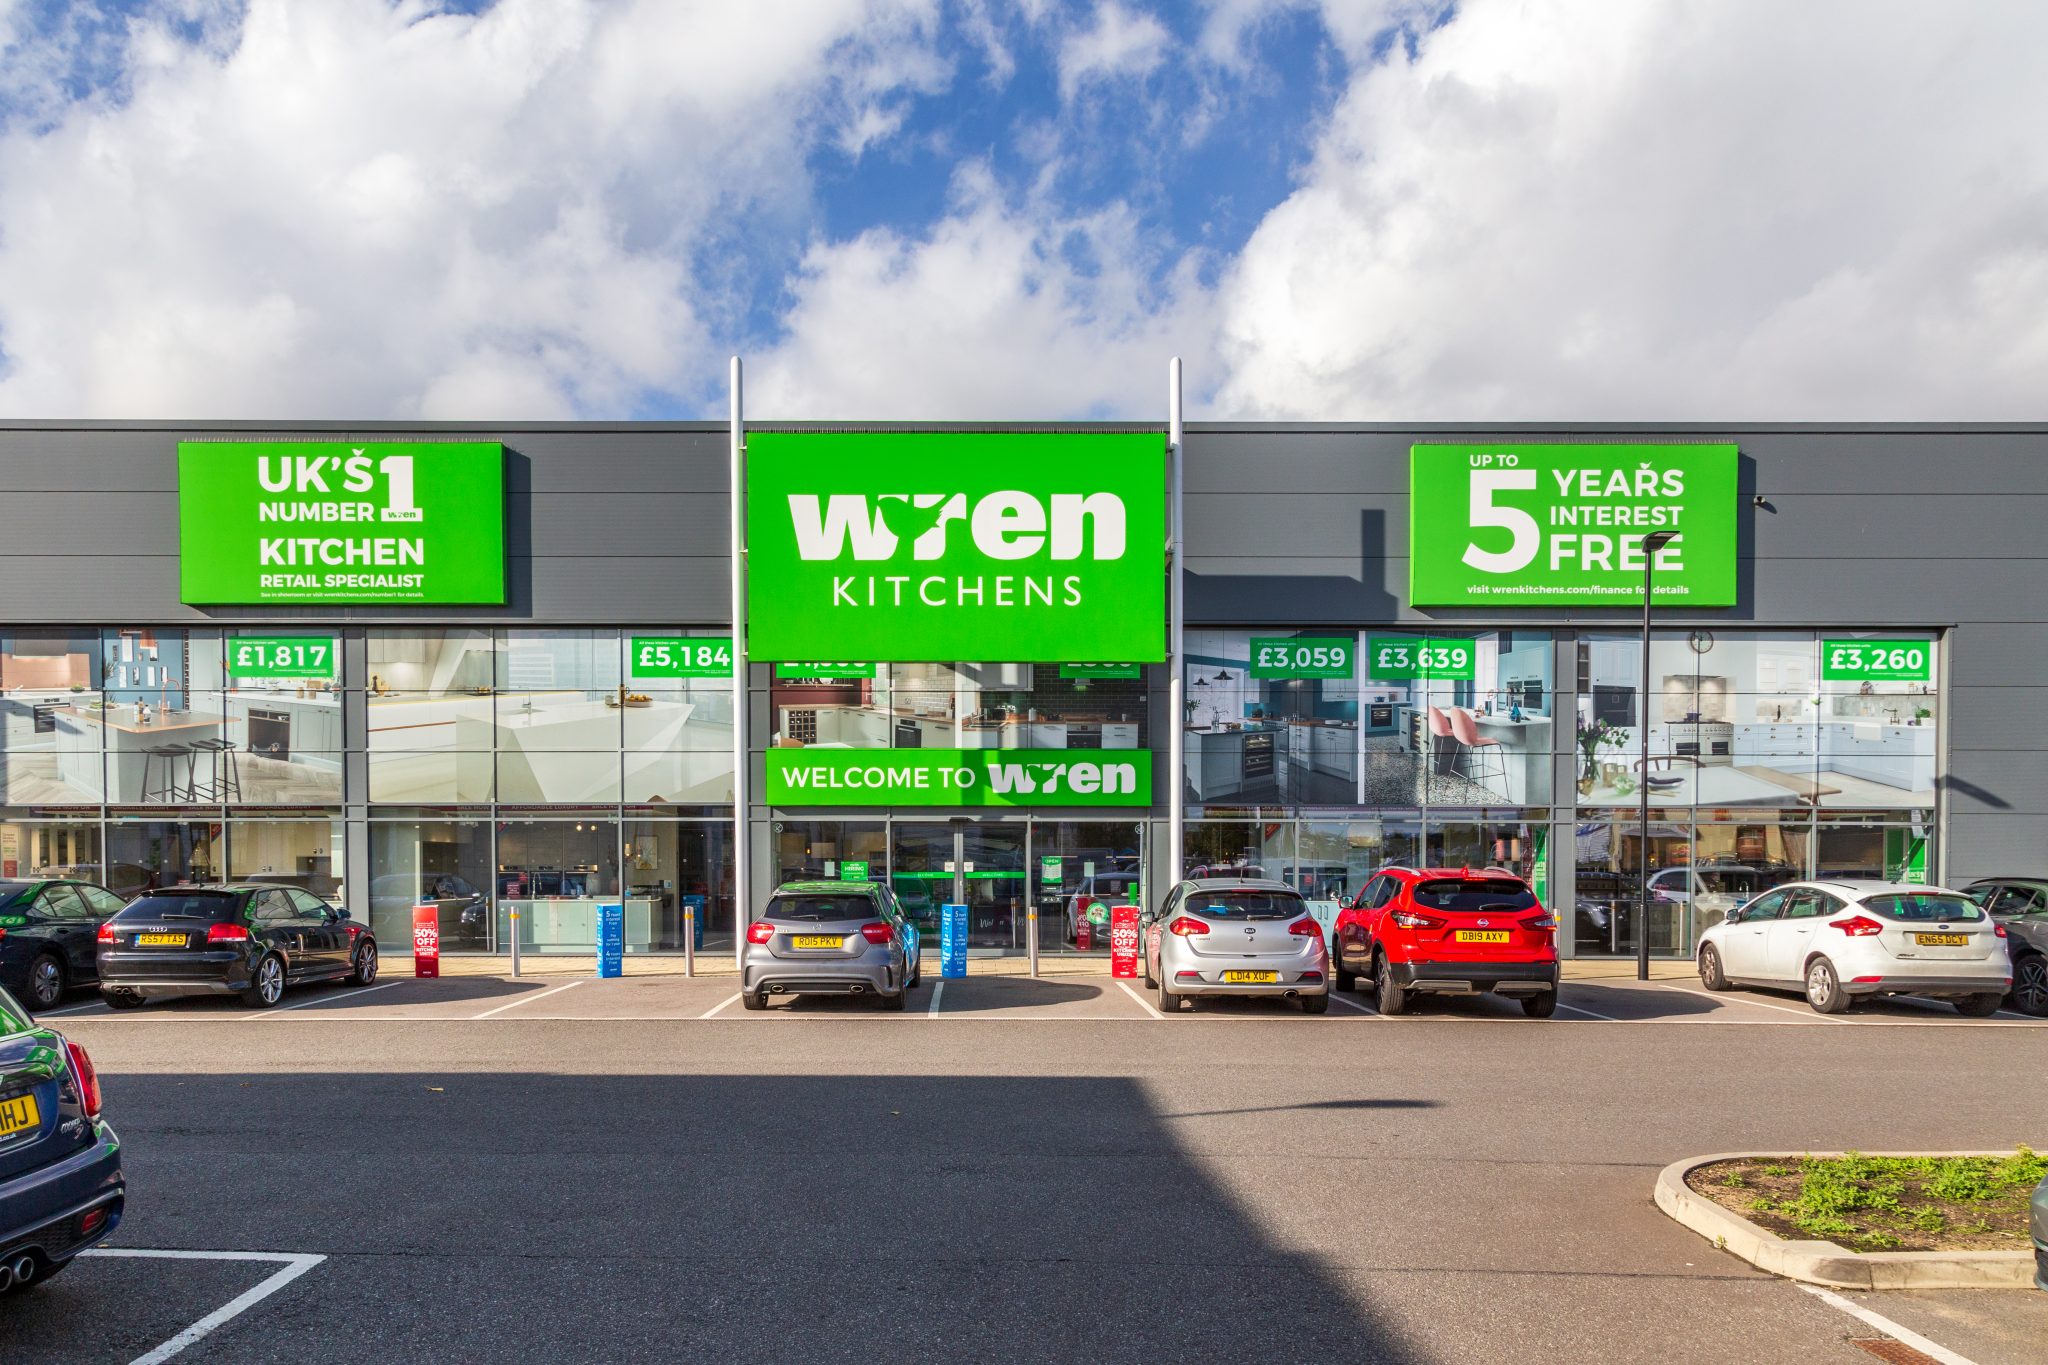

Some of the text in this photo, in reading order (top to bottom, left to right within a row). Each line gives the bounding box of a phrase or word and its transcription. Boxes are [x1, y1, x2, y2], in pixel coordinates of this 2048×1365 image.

[1470, 454, 1519, 467] UP TO
[258, 454, 374, 493] UK'S
[1551, 468, 1685, 498] YEARS
[259, 455, 423, 522] NUMBER 1
[388, 511, 416, 519] wren
[1462, 469, 1541, 574] 5
[1551, 506, 1684, 526] INTEREST
[787, 490, 1126, 561] wren
[260, 538, 424, 566] KITCHEN
[1550, 533, 1684, 571] FREE
[260, 574, 425, 588] RETAIL SPECIALIST
[833, 575, 1082, 607] KITCHENS
[1467, 585, 1689, 595] visit wrenkitchens.com/finance fo details
[237, 646, 327, 668] £1,817
[639, 646, 731, 669] £5,184
[1258, 647, 1346, 670] £3,059
[1378, 647, 1468, 670] £3,639
[1830, 649, 1923, 672] £3,260
[781, 762, 1136, 794] WELCOME TO wren
[605, 910, 611, 918] 5
[141, 934, 184, 943] RS57 TAS
[415, 928, 437, 938] 50%
[416, 937, 436, 946] OFF
[820, 937, 837, 946] PKV
[1112, 928, 1138, 939] 50%
[1114, 938, 1135, 946] OFF
[1462, 931, 1504, 941] DB19 AXY
[1918, 935, 1963, 944] EN65 DCY
[1230, 971, 1270, 981] LD14 XUF
